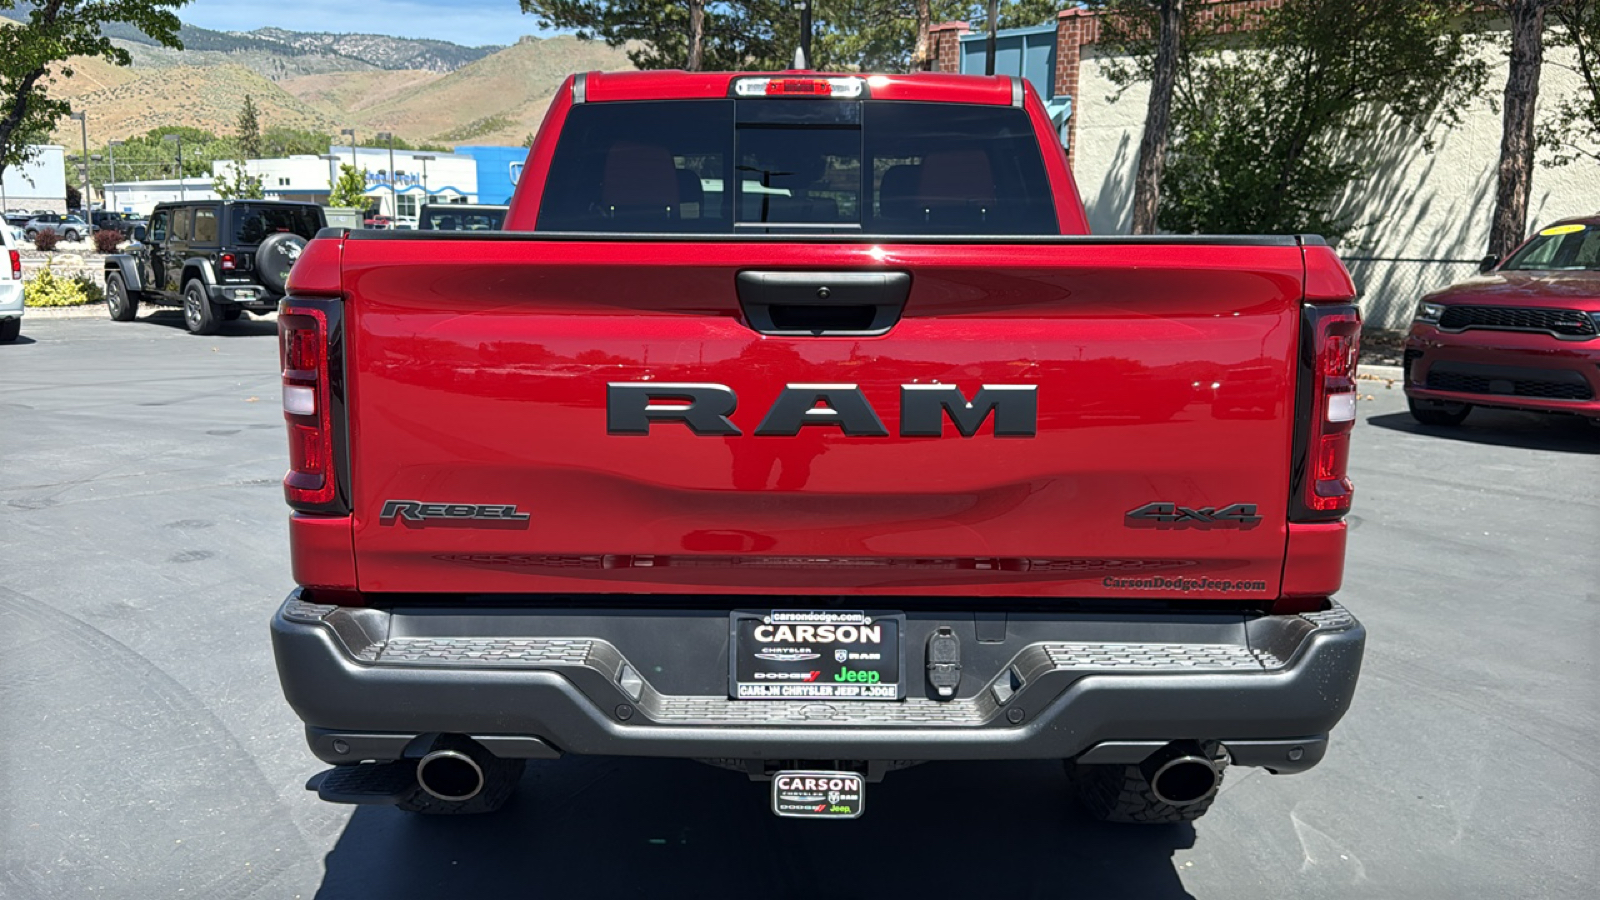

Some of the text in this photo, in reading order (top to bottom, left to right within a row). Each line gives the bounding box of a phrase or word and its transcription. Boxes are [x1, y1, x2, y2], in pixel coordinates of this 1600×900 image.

[606, 382, 1039, 438] RAM
[379, 499, 531, 521] REBEL
[1102, 575, 1267, 593] CarsonDodgeJeep.com
[773, 611, 863, 622] carsondodge.com
[754, 625, 881, 643] CARSON
[834, 666, 880, 684] Jeep
[782, 686, 833, 696] CHRYSLER
[835, 686, 859, 696] JEEP
[778, 778, 859, 791] CARSON
[830, 804, 851, 814] Jeep
